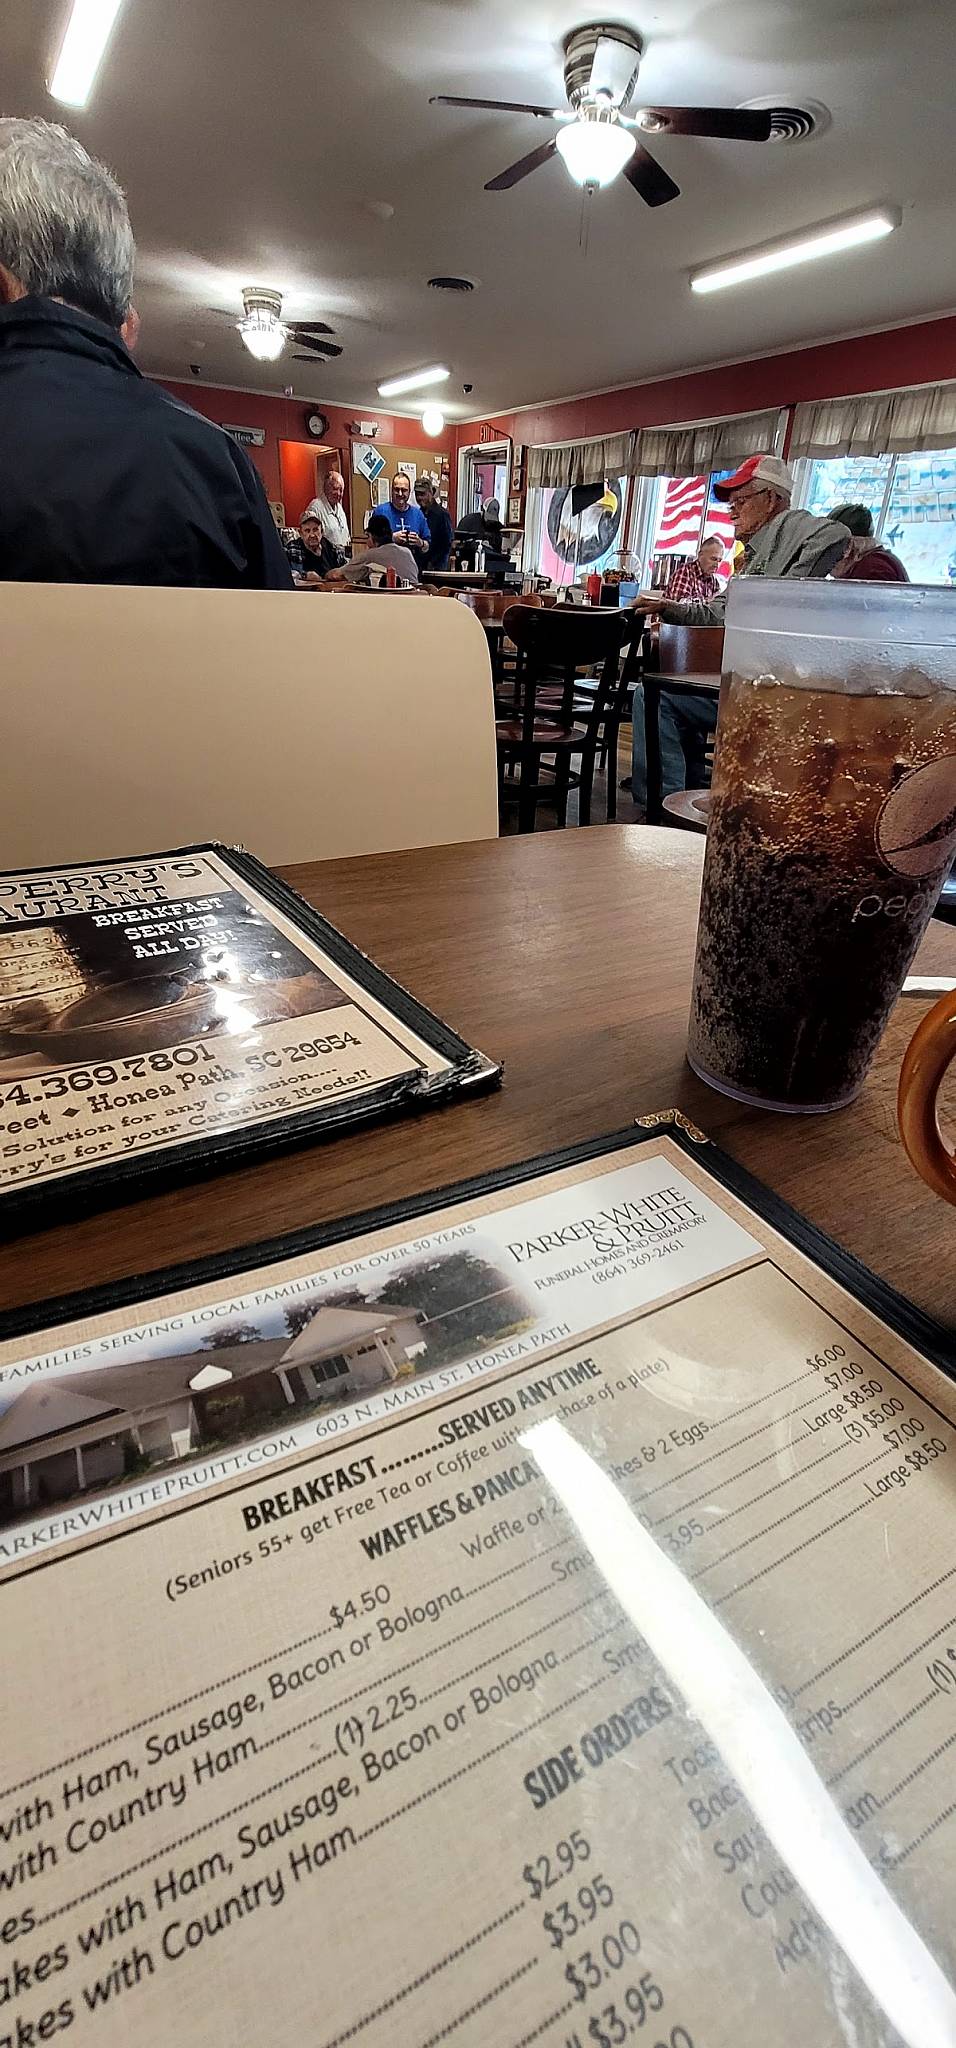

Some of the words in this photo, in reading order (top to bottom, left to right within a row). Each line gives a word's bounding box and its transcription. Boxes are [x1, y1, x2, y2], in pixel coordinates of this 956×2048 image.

[92, 898, 224, 927] BREAKFAST
[124, 914, 218, 940] SERVED
[132, 937, 180, 958] ALL
[179, 930, 238, 950] DAY!
[0, 1043, 216, 1109] 4.369.7801
[0, 1109, 51, 1134] eet
[87, 1084, 176, 1114] Honea
[245, 1051, 282, 1072] SC
[283, 1032, 362, 1062] 29654
[74, 1141, 113, 1157] for
[122, 1123, 181, 1148] your
[188, 1095, 291, 1128] Catering
[291, 1069, 372, 1100] Needs!!
[2, 1123, 115, 1158] Solution
[121, 1112, 156, 1127] for
[164, 1100, 208, 1117] any
[504, 1186, 686, 1263] PARKER-WHITE
[534, 1264, 587, 1291] FUNERAL
[583, 1248, 627, 1270] HOMES
[625, 1238, 650, 1254] AND
[646, 1215, 708, 1244] CREMATORY
[591, 1263, 627, 1286] (864)
[630, 1239, 687, 1269] 369-2461
[592, 1233, 619, 1253] &
[615, 1201, 701, 1244] PRUITT
[0, 1346, 92, 1383] FAMILIES
[100, 1318, 184, 1352] SERVING
[191, 1300, 250, 1325] LOCAL
[254, 1274, 328, 1306] FAMILIES
[332, 1263, 367, 1281] FOR
[368, 1247, 410, 1269] OVER
[413, 1238, 431, 1252] 50
[433, 1224, 477, 1246] YEARS
[315, 1414, 350, 1438] 603
[354, 1404, 380, 1421] N.
[382, 1380, 436, 1411] MAIN
[438, 1369, 464, 1388] ST.
[466, 1341, 530, 1375] HONEA
[530, 1323, 573, 1347] PATH
[516, 1358, 603, 1411] ANYTIME
[165, 1550, 253, 1602] (Seniors
[258, 1532, 294, 1559] 55+
[299, 1515, 333, 1544] get
[333, 1498, 376, 1525] Free
[376, 1482, 411, 1504] Tea
[415, 1470, 433, 1488] or
[435, 1445, 490, 1477] Coffee
[597, 1382, 616, 1401] of
[616, 1378, 628, 1391] a
[628, 1358, 670, 1389] plate)
[459, 1519, 526, 1559] Waffle
[527, 1505, 546, 1527] or
[640, 1446, 657, 1464] &
[657, 1438, 674, 1455] 2
[670, 1421, 712, 1450] Eggs
[806, 1344, 846, 1372] $6.00
[359, 1500, 457, 1561] WAFFLES
[456, 1491, 475, 1516] &
[471, 1460, 541, 1508] PANCA
[62, 1759, 139, 1811] Ham,
[145, 1692, 265, 1766] Sausage,
[267, 1649, 346, 1701] Bacon
[350, 1632, 373, 1657] or
[376, 1586, 465, 1643] Bologna
[824, 1362, 865, 1391] $7.00
[66, 1774, 187, 1854] Country
[192, 1736, 258, 1786] Ham
[803, 1402, 848, 1433] Large
[842, 1380, 884, 1409] $8.50
[328, 1584, 391, 1630] $4.50
[334, 1715, 365, 1757] (1)
[366, 1686, 418, 1734] 2.25
[843, 1420, 871, 1444] (3)
[862, 1398, 905, 1430] $5.00
[77, 1895, 147, 1956] with
[153, 1851, 234, 1911] Ham,
[237, 1776, 361, 1860] Sausage,
[360, 1723, 441, 1784] Bacon
[443, 1703, 467, 1732] or
[469, 1650, 561, 1717] Bologna
[883, 1417, 926, 1450] $7.00
[82, 1946, 155, 2012] with
[161, 1868, 286, 1962] Country
[288, 1826, 358, 1882] Ham
[863, 1465, 911, 1499] Large
[904, 1438, 948, 1472] $8.50
[522, 1744, 585, 1811] SIDE
[579, 1685, 673, 1770] ORDERS
[522, 1829, 592, 1902] $2.95
[542, 1874, 614, 1950] $3.95
[565, 1920, 641, 2004] $3.00
